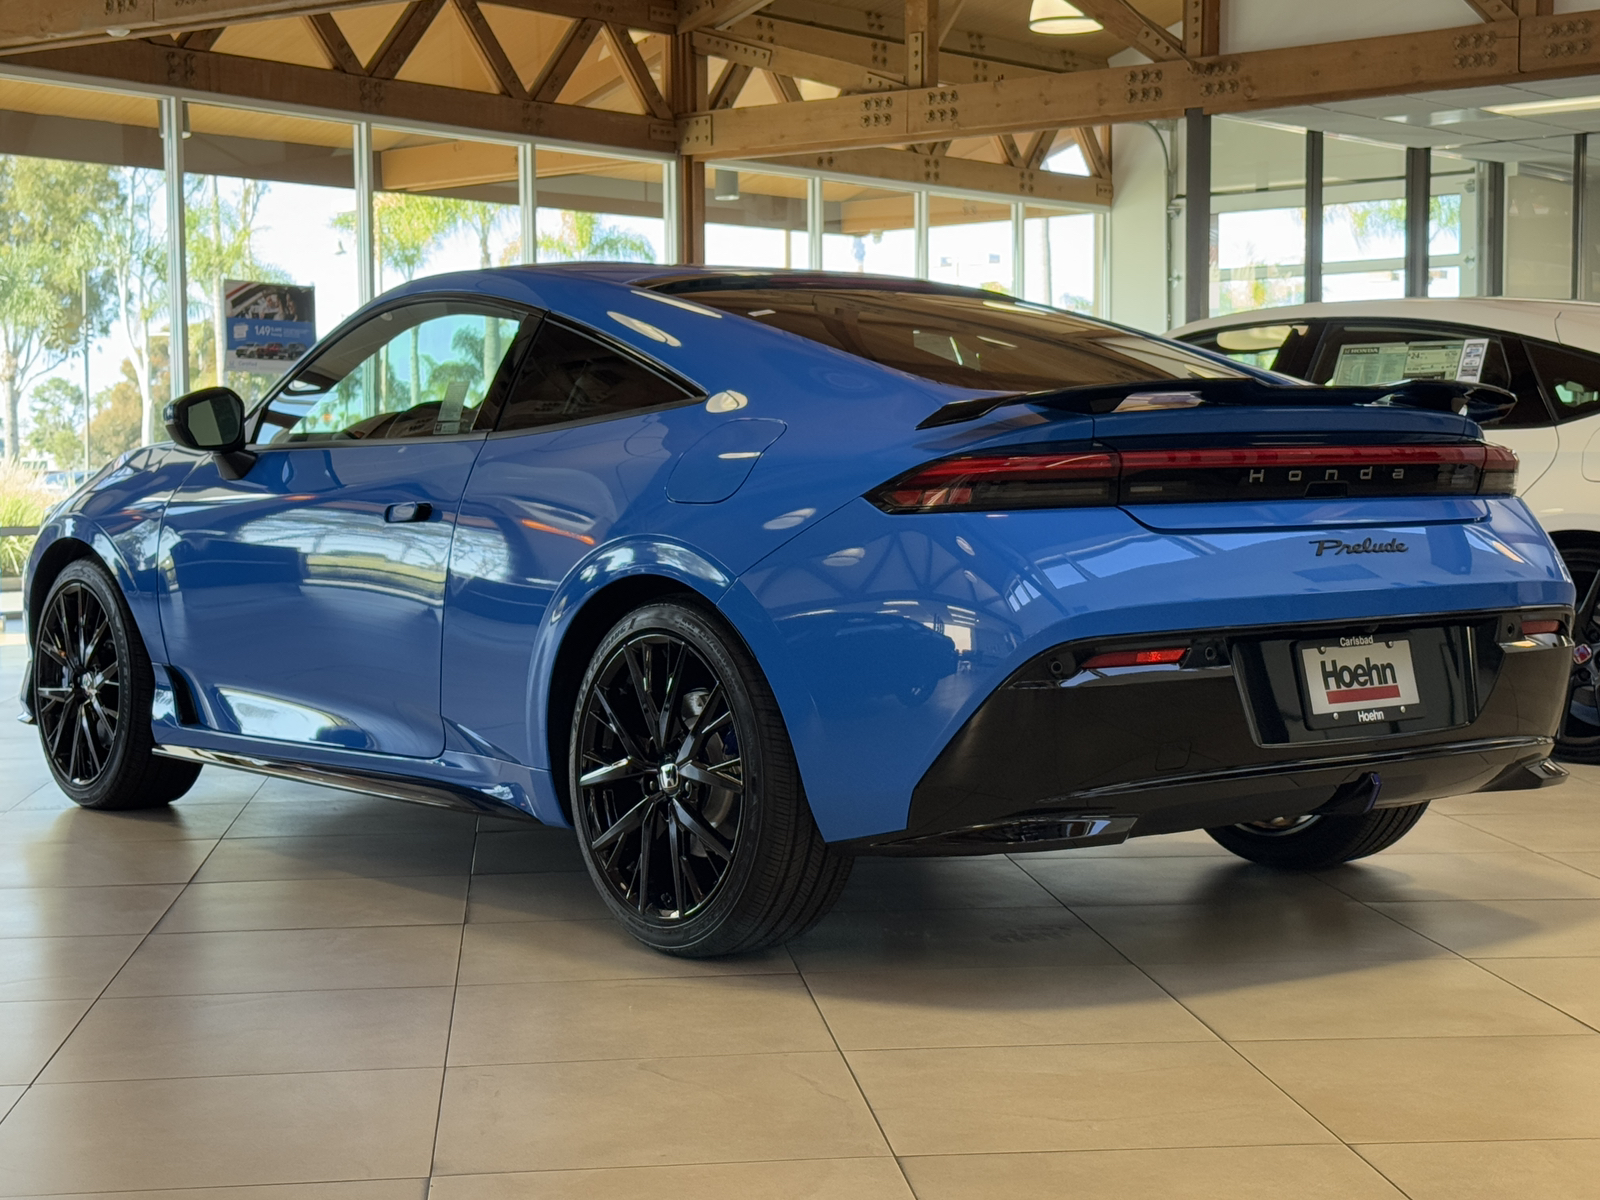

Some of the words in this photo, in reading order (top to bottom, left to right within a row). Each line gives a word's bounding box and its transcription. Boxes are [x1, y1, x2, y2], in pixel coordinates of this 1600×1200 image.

[1249, 466, 1404, 483] Honda
[1309, 537, 1409, 557] Prelude
[1340, 635, 1374, 647] Carlsbad
[1320, 657, 1398, 690] Hoehn
[1357, 709, 1385, 722] Hoehn
